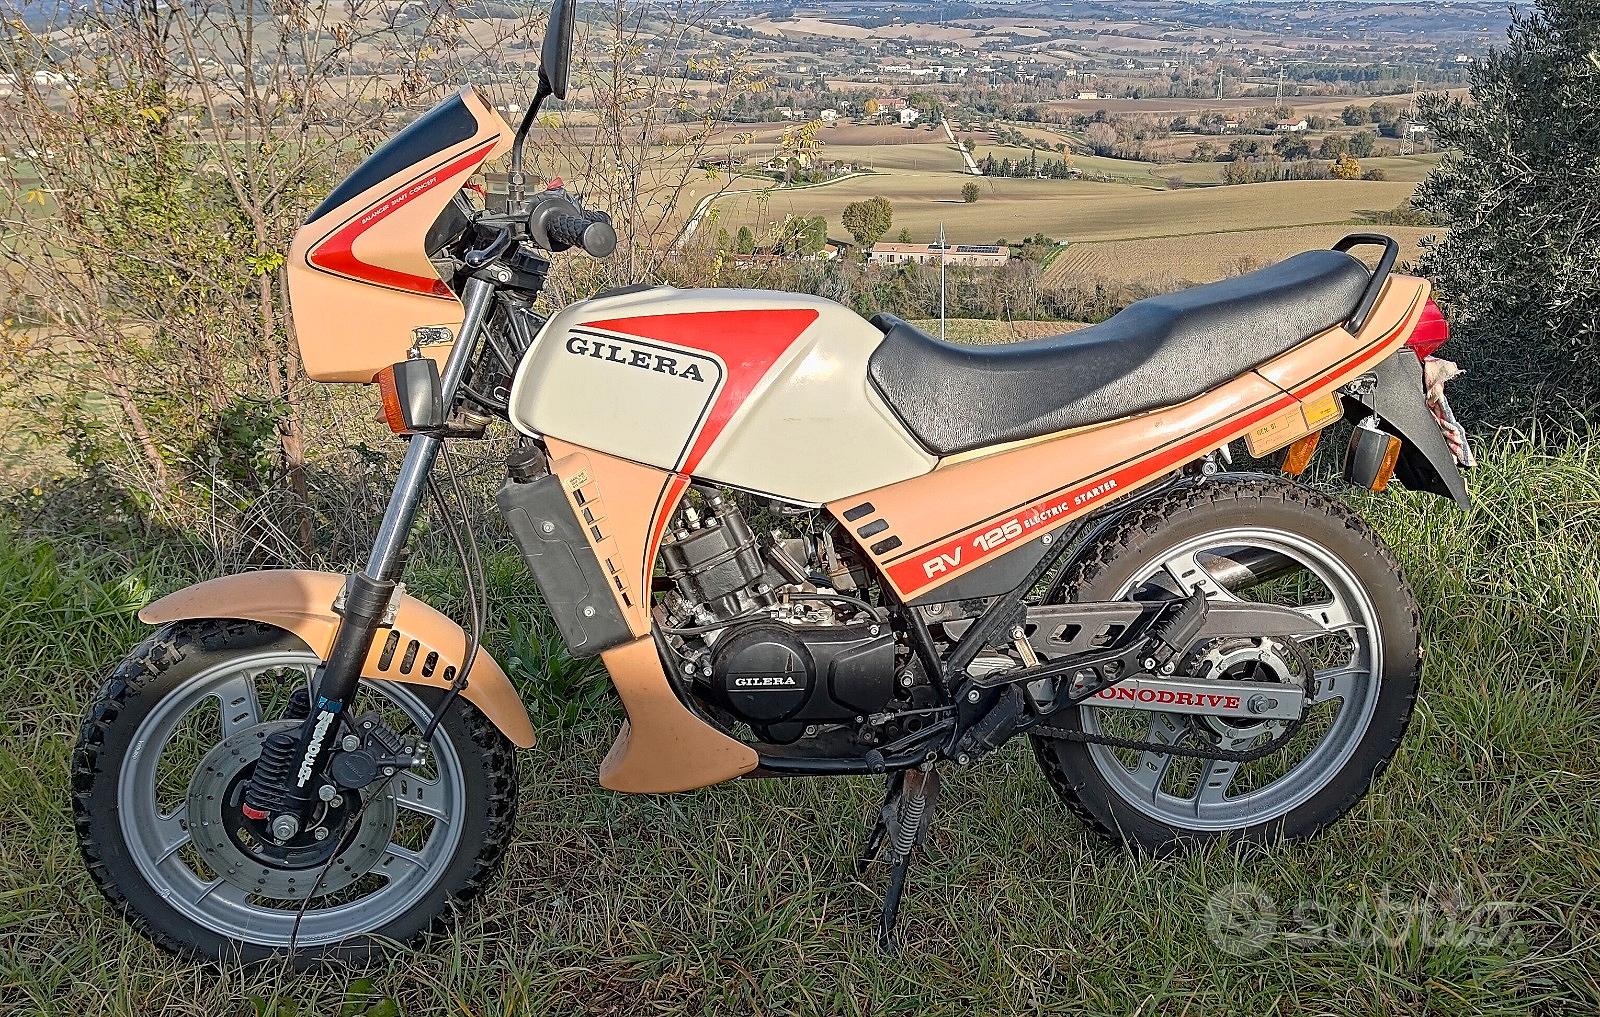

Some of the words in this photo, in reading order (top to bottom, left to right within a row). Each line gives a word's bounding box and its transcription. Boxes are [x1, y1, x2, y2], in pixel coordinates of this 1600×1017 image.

[361, 205, 389, 224] BALANCER
[409, 177, 438, 196] CONCEPT
[565, 337, 704, 383] GILERA
[922, 546, 962, 579] RV
[972, 518, 1023, 552] 125
[1023, 502, 1069, 529] ELECTRIC
[1074, 479, 1118, 506] STARTER
[735, 676, 796, 687] GILERA
[1090, 687, 1241, 709] ONODRIVE
